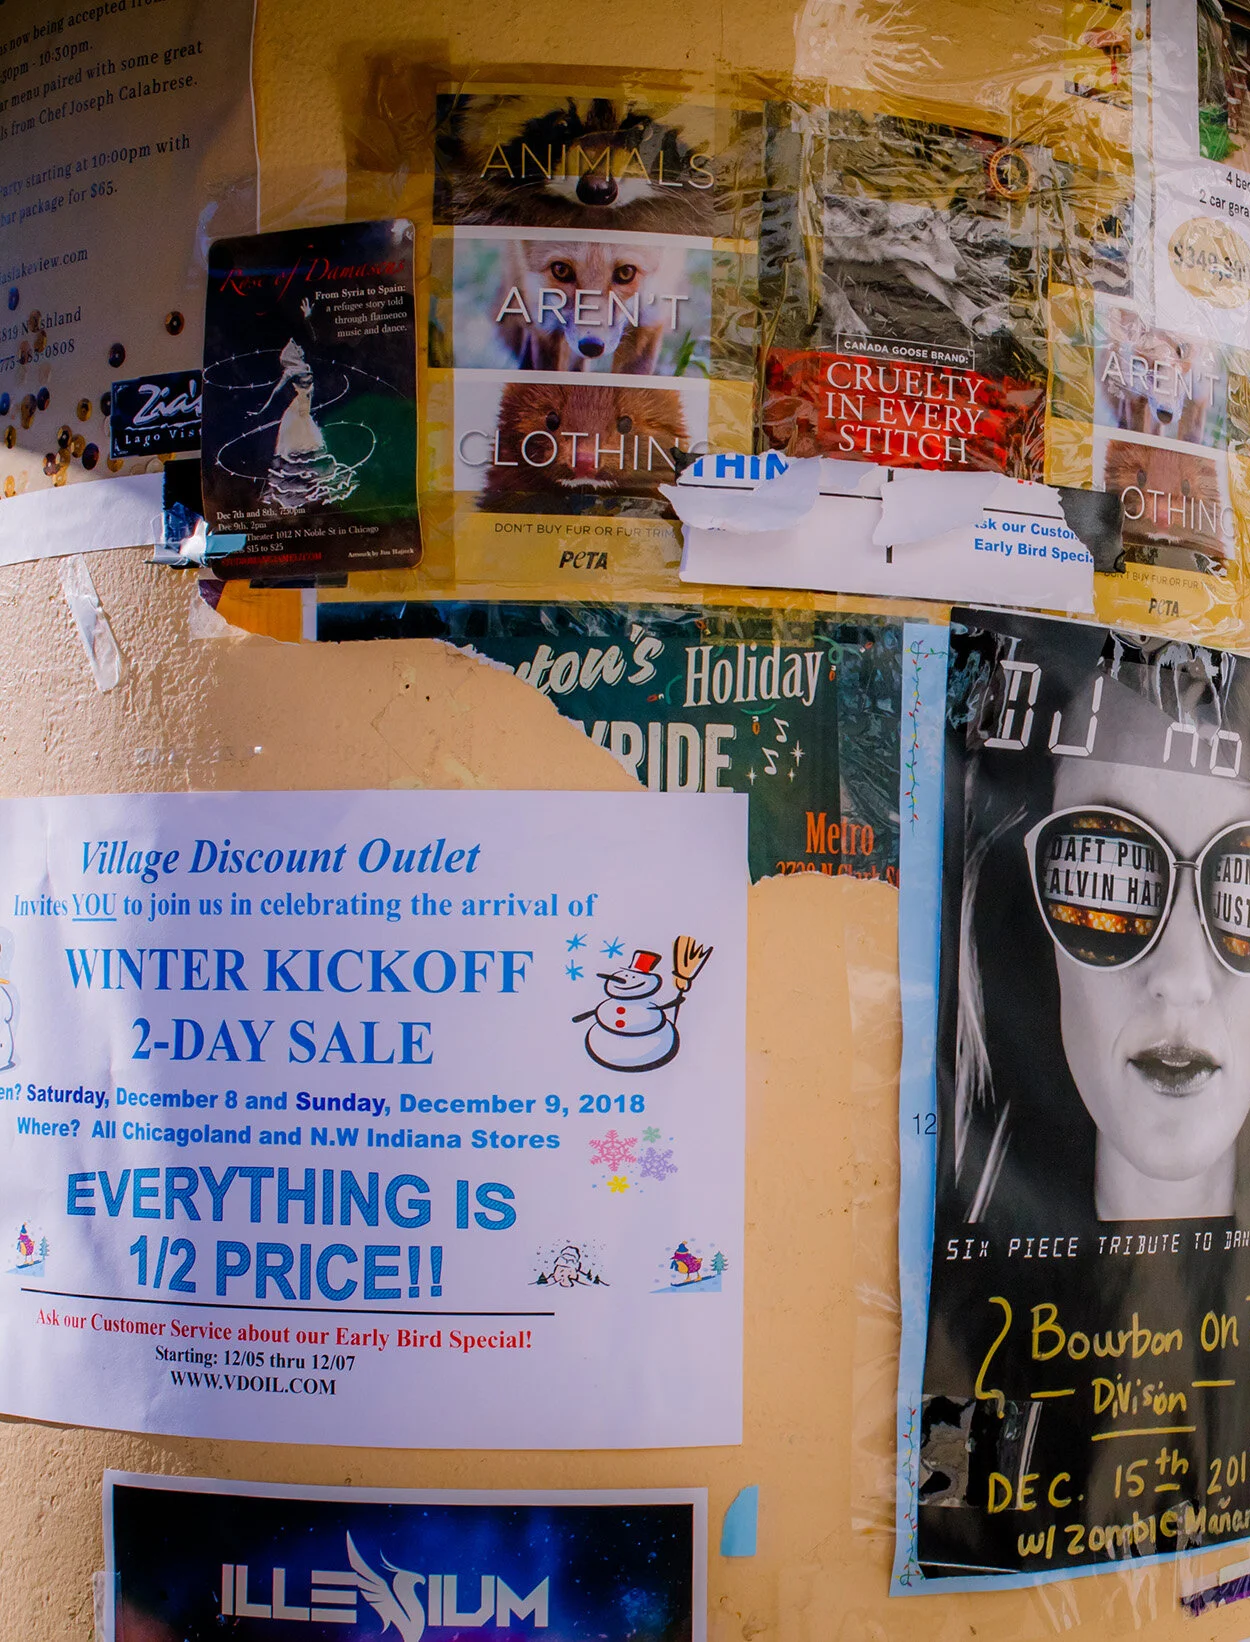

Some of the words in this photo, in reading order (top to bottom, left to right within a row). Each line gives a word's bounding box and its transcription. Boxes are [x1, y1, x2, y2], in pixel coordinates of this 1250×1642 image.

[10, 31, 31, 50] now
[33, 17, 64, 40] being
[67, 1, 126, 27] accepted
[39, 40, 93, 66] 10:30pm.
[11, 87, 40, 107] menu
[43, 68, 82, 97] paired
[86, 59, 116, 80] with
[121, 52, 158, 72] some
[163, 40, 204, 65] great
[11, 117, 36, 136] from
[39, 102, 67, 124] Chef
[69, 90, 114, 115] Joseph
[118, 73, 198, 100] Calabrese.
[25, 162, 72, 188] starting
[75, 158, 88, 173] at
[91, 144, 151, 168] 10:00pm
[156, 134, 190, 154] with
[480, 142, 715, 190] ANIMALS
[1226, 171, 1233, 185] 4
[19, 195, 64, 224] package
[68, 188, 86, 204] for
[90, 181, 118, 198] $65.
[1199, 189, 1207, 204] 2
[1209, 194, 1225, 209] car
[315, 291, 339, 300] From
[341, 288, 365, 299] Syria
[367, 287, 376, 295] to
[378, 284, 406, 296] Spain:
[334, 301, 363, 313] refugee
[365, 300, 385, 309] story
[387, 296, 403, 306] told
[496, 286, 689, 330] AREN'T
[335, 312, 368, 325] through
[370, 311, 407, 321] flamenco
[337, 327, 362, 337] music
[364, 325, 379, 335] and
[382, 323, 407, 333] dance.
[843, 339, 889, 353] CANADA
[892, 344, 928, 358] GOOSE
[931, 350, 970, 364] BRAND:
[826, 363, 985, 406] CRUELTY
[1101, 352, 1220, 405] AREN'T
[825, 392, 868, 421] IN
[878, 396, 985, 437] EVERY
[125, 433, 161, 446] Lago
[838, 424, 969, 464] STITCH
[217, 512, 231, 520] Dec
[247, 509, 260, 518] and
[495, 523, 533, 534] DON'T
[537, 524, 562, 534] BUY
[566, 525, 590, 535] FUR
[595, 526, 612, 536] OR
[617, 527, 641, 537] FUR
[1002, 522, 1027, 535] our
[1121, 486, 1235, 537] OTHIN
[247, 532, 273, 541] Theater
[276, 530, 292, 539] 1012
[304, 528, 325, 537] Noble
[349, 525, 379, 534] Chicago
[974, 538, 1014, 557] Early
[1018, 542, 1048, 558] Bird
[684, 646, 824, 708] Holiday
[983, 659, 1104, 757] DJ
[806, 811, 874, 856] Metro
[81, 839, 179, 884] Village
[189, 838, 346, 873] Discount
[358, 837, 480, 873] Outlet
[1051, 836, 1106, 864] DAFT
[1117, 841, 1161, 873] PUN
[13, 893, 68, 917] Invites
[72, 894, 116, 918] YOU
[123, 895, 143, 916] to
[147, 893, 191, 922] join
[199, 899, 222, 917] us
[230, 893, 252, 917] in
[261, 893, 402, 922] celebrating
[411, 893, 452, 917] the
[461, 893, 558, 918] arrival
[568, 893, 598, 918] of
[65, 948, 249, 992] WINTER
[263, 950, 533, 994] KICKOFF
[132, 1018, 274, 1063] 2-DAY
[288, 1019, 434, 1065] SALE
[26, 1086, 110, 1110] Saturday,
[116, 1088, 219, 1110] December
[224, 1090, 239, 1110] 8
[245, 1091, 288, 1111] and
[296, 1092, 391, 1117] Sunday,
[399, 1094, 537, 1114] December
[544, 1095, 569, 1118] 9,
[578, 1095, 645, 1113] 2018
[17, 1117, 80, 1139] Where?
[92, 1120, 116, 1140] All
[122, 1122, 252, 1147] Chicagoland
[259, 1125, 301, 1146] and
[311, 1127, 359, 1147] N.W
[367, 1128, 462, 1149] Indiana
[471, 1129, 561, 1150] Stores
[913, 1113, 937, 1135] 12
[66, 1167, 432, 1230] EVERYTHING
[456, 1180, 517, 1231] IS
[946, 1239, 988, 1260] SIX
[1008, 1237, 1079, 1258] PIECE
[1099, 1234, 1180, 1256] TRIBUTE
[1194, 1232, 1211, 1251] TO
[129, 1235, 196, 1293] 1/2
[216, 1240, 444, 1301] PRICE!!
[36, 1308, 59, 1329] Ask
[63, 1313, 87, 1331] our
[91, 1313, 165, 1338] Customer
[170, 1319, 232, 1341] Service
[238, 1322, 289, 1343] about
[296, 1329, 329, 1345] our
[336, 1327, 389, 1352] Early
[396, 1328, 441, 1349] Bird
[449, 1329, 532, 1355] Special!
[1031, 1302, 1183, 1361] Bourbon
[155, 1345, 219, 1369] Starting:
[223, 1348, 266, 1369] 12/05
[270, 1351, 307, 1370] thru
[311, 1353, 356, 1372] 12/07
[170, 1369, 337, 1397] WWW.VDOIL.COM
[1092, 1373, 1186, 1417] Division
[988, 1472, 1084, 1514] DEC.
[1115, 1447, 1188, 1498] 15th
[1018, 1526, 1055, 1558] w/
